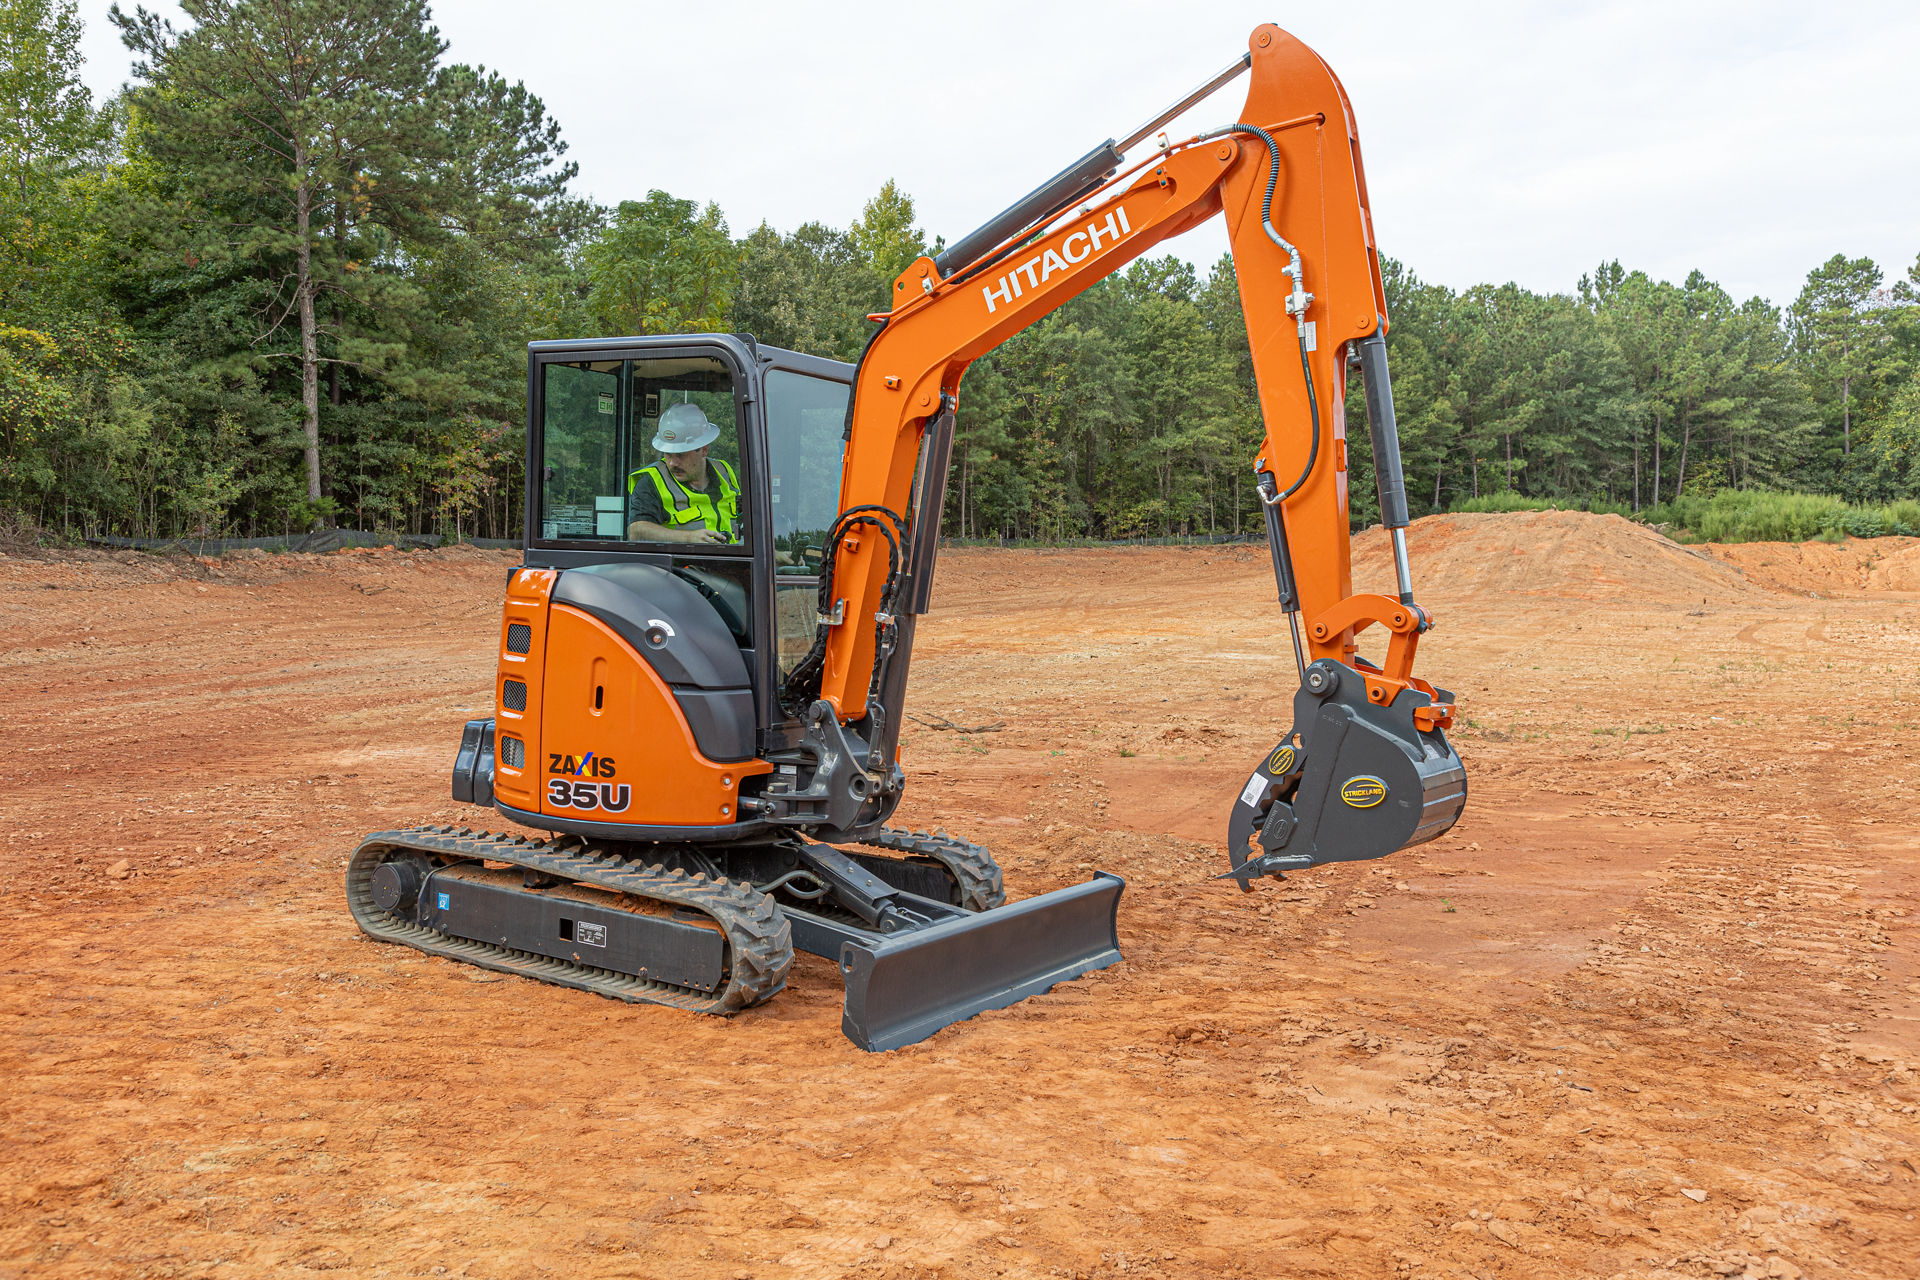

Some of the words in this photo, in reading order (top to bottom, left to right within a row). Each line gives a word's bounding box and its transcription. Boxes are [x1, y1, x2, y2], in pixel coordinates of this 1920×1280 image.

[982, 205, 1131, 314] HITACHI
[549, 752, 616, 778] ZAXIS
[547, 778, 631, 813] 35U
[1344, 788, 1382, 798] STRICKLAND
